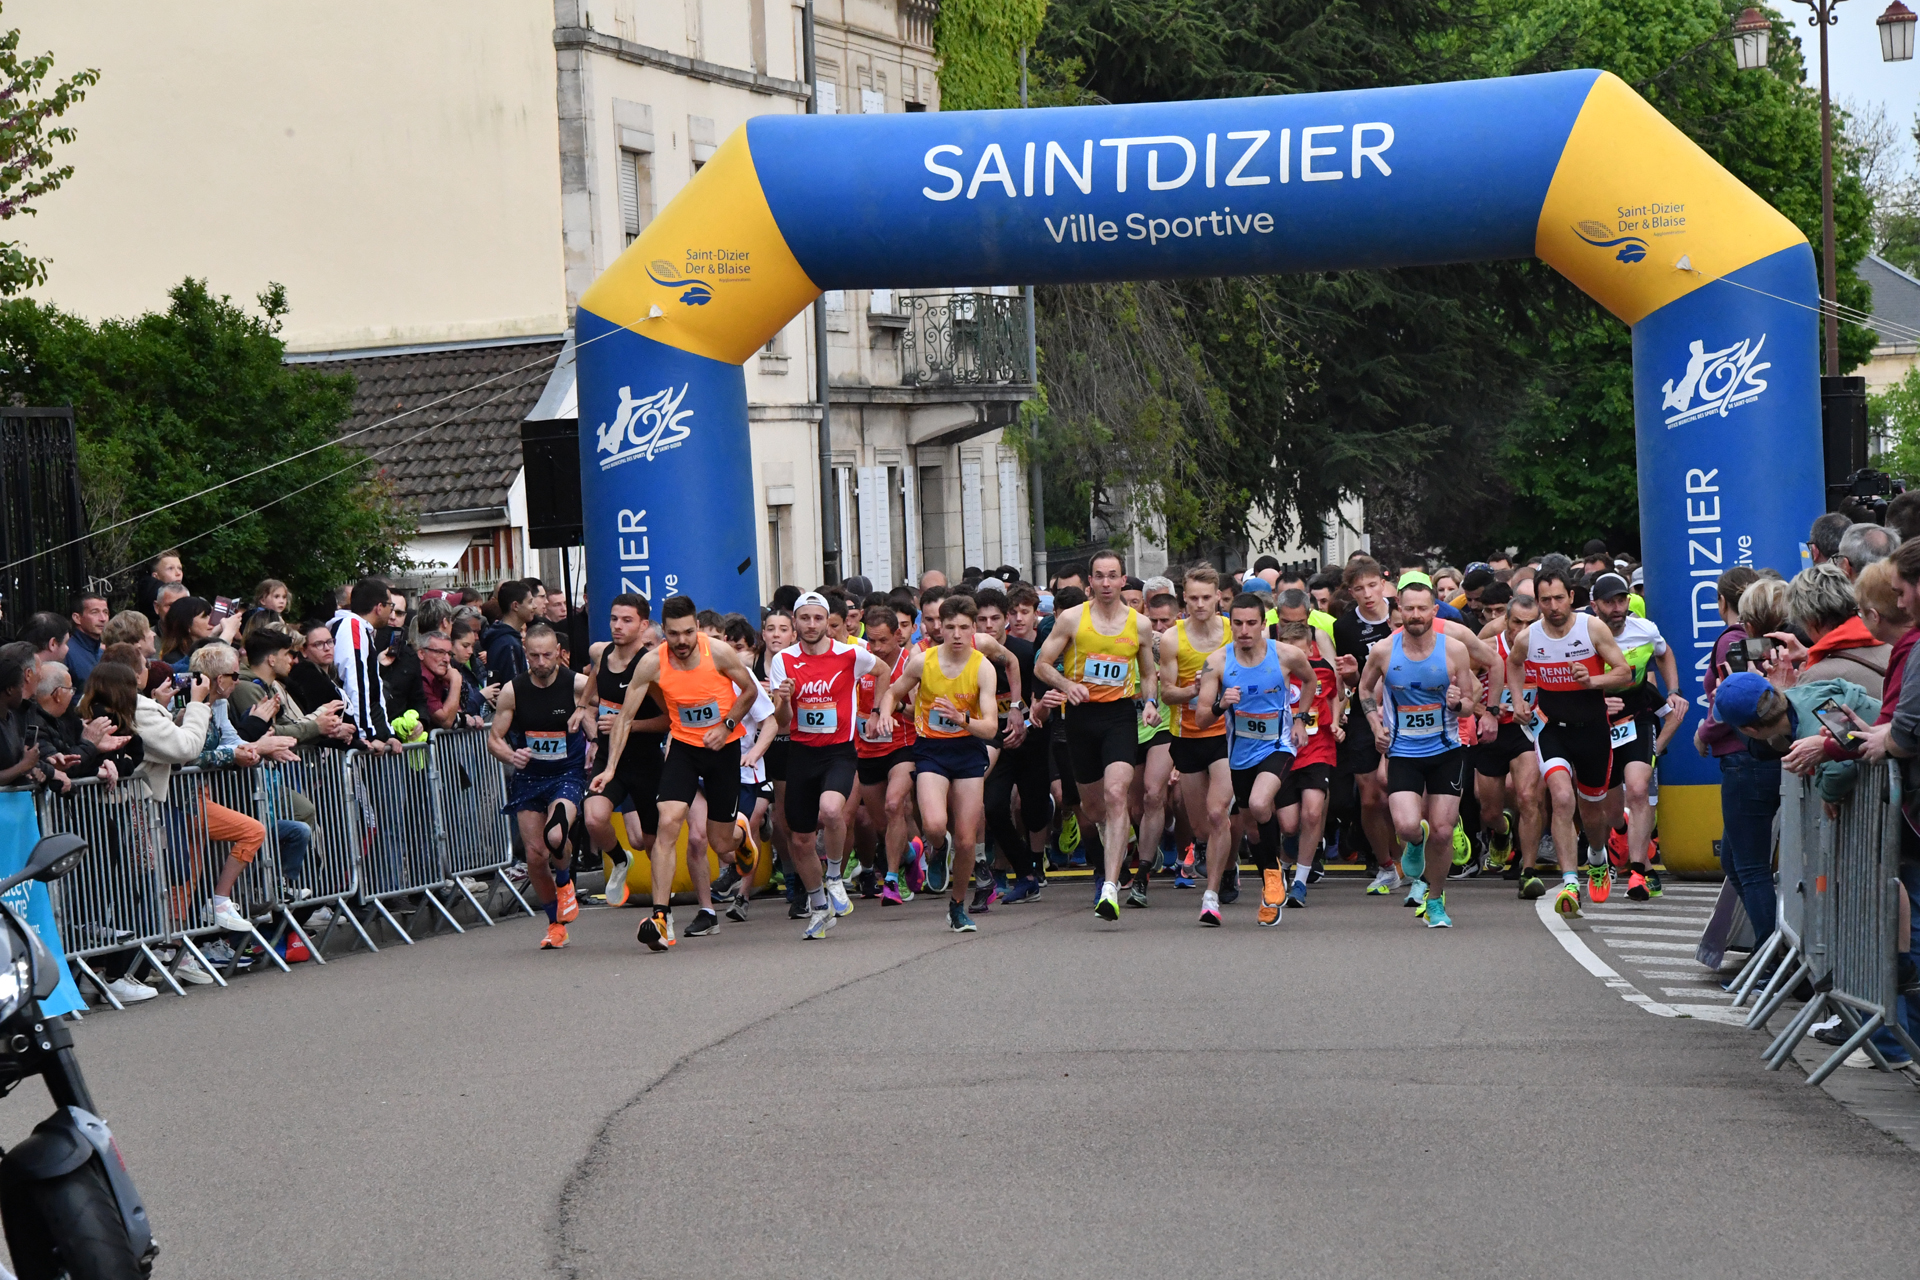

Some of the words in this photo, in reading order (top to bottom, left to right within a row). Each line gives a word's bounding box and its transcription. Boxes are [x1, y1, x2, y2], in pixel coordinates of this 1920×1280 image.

[1617, 202, 1685, 218] Saint-Dizier
[1044, 213, 1119, 243] Ville
[1125, 206, 1275, 245] Sportive
[1618, 219, 1640, 232] Der
[1642, 219, 1650, 230] &
[1652, 215, 1686, 229] Blaise
[686, 249, 749, 261] Saint-Dizier
[686, 263, 705, 274] Der
[707, 264, 716, 274] &
[717, 263, 751, 274] Blaise
[1093, 662, 1120, 679] 110
[1539, 666, 1571, 676] RENN
[1505, 691, 1531, 704] 24
[685, 706, 713, 722] 179
[806, 712, 825, 726] 62
[1405, 713, 1435, 728] 255
[1247, 720, 1266, 733] 96
[532, 740, 559, 753] 447
